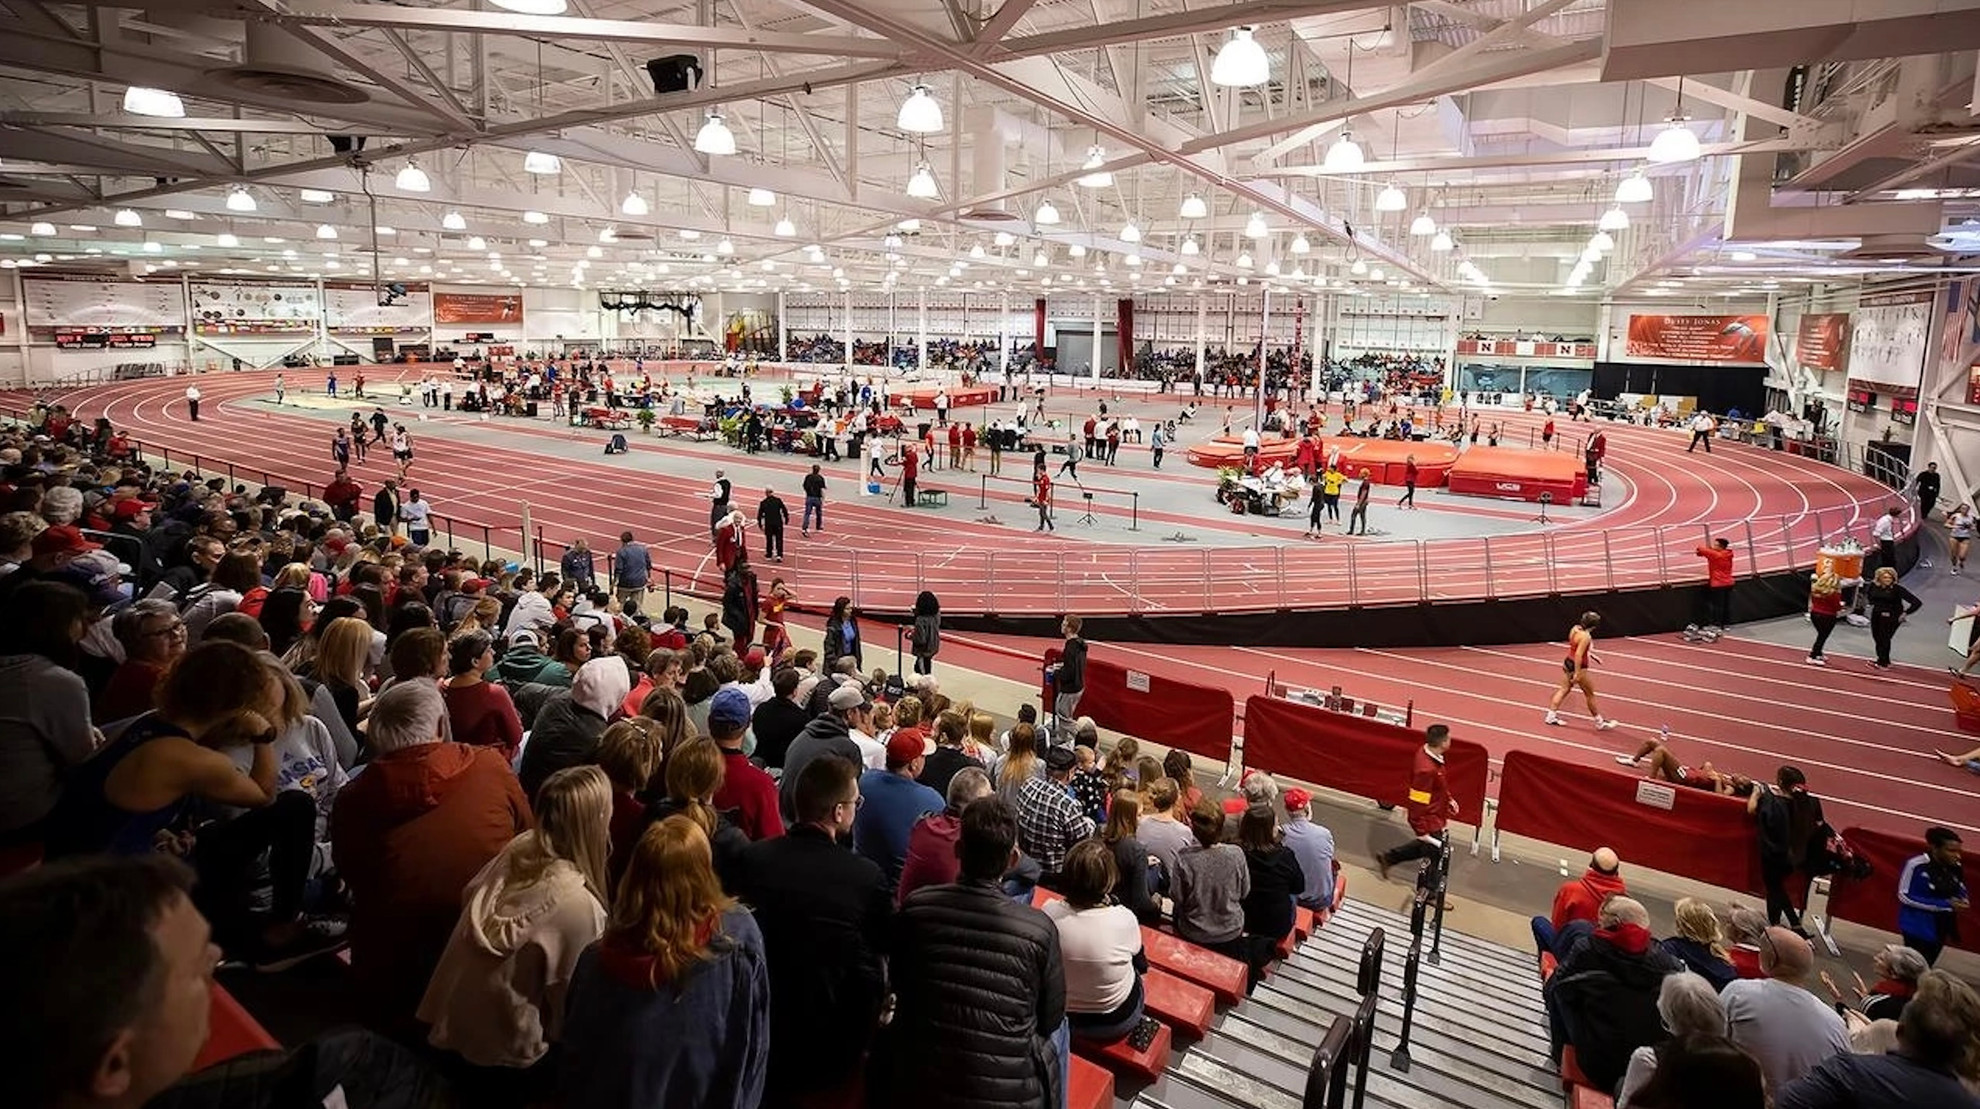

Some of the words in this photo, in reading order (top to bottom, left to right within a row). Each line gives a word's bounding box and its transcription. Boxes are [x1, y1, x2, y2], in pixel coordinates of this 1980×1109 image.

[1694, 317, 1721, 326] JONAS
[1481, 342, 1491, 352] N
[1561, 344, 1571, 354] N
